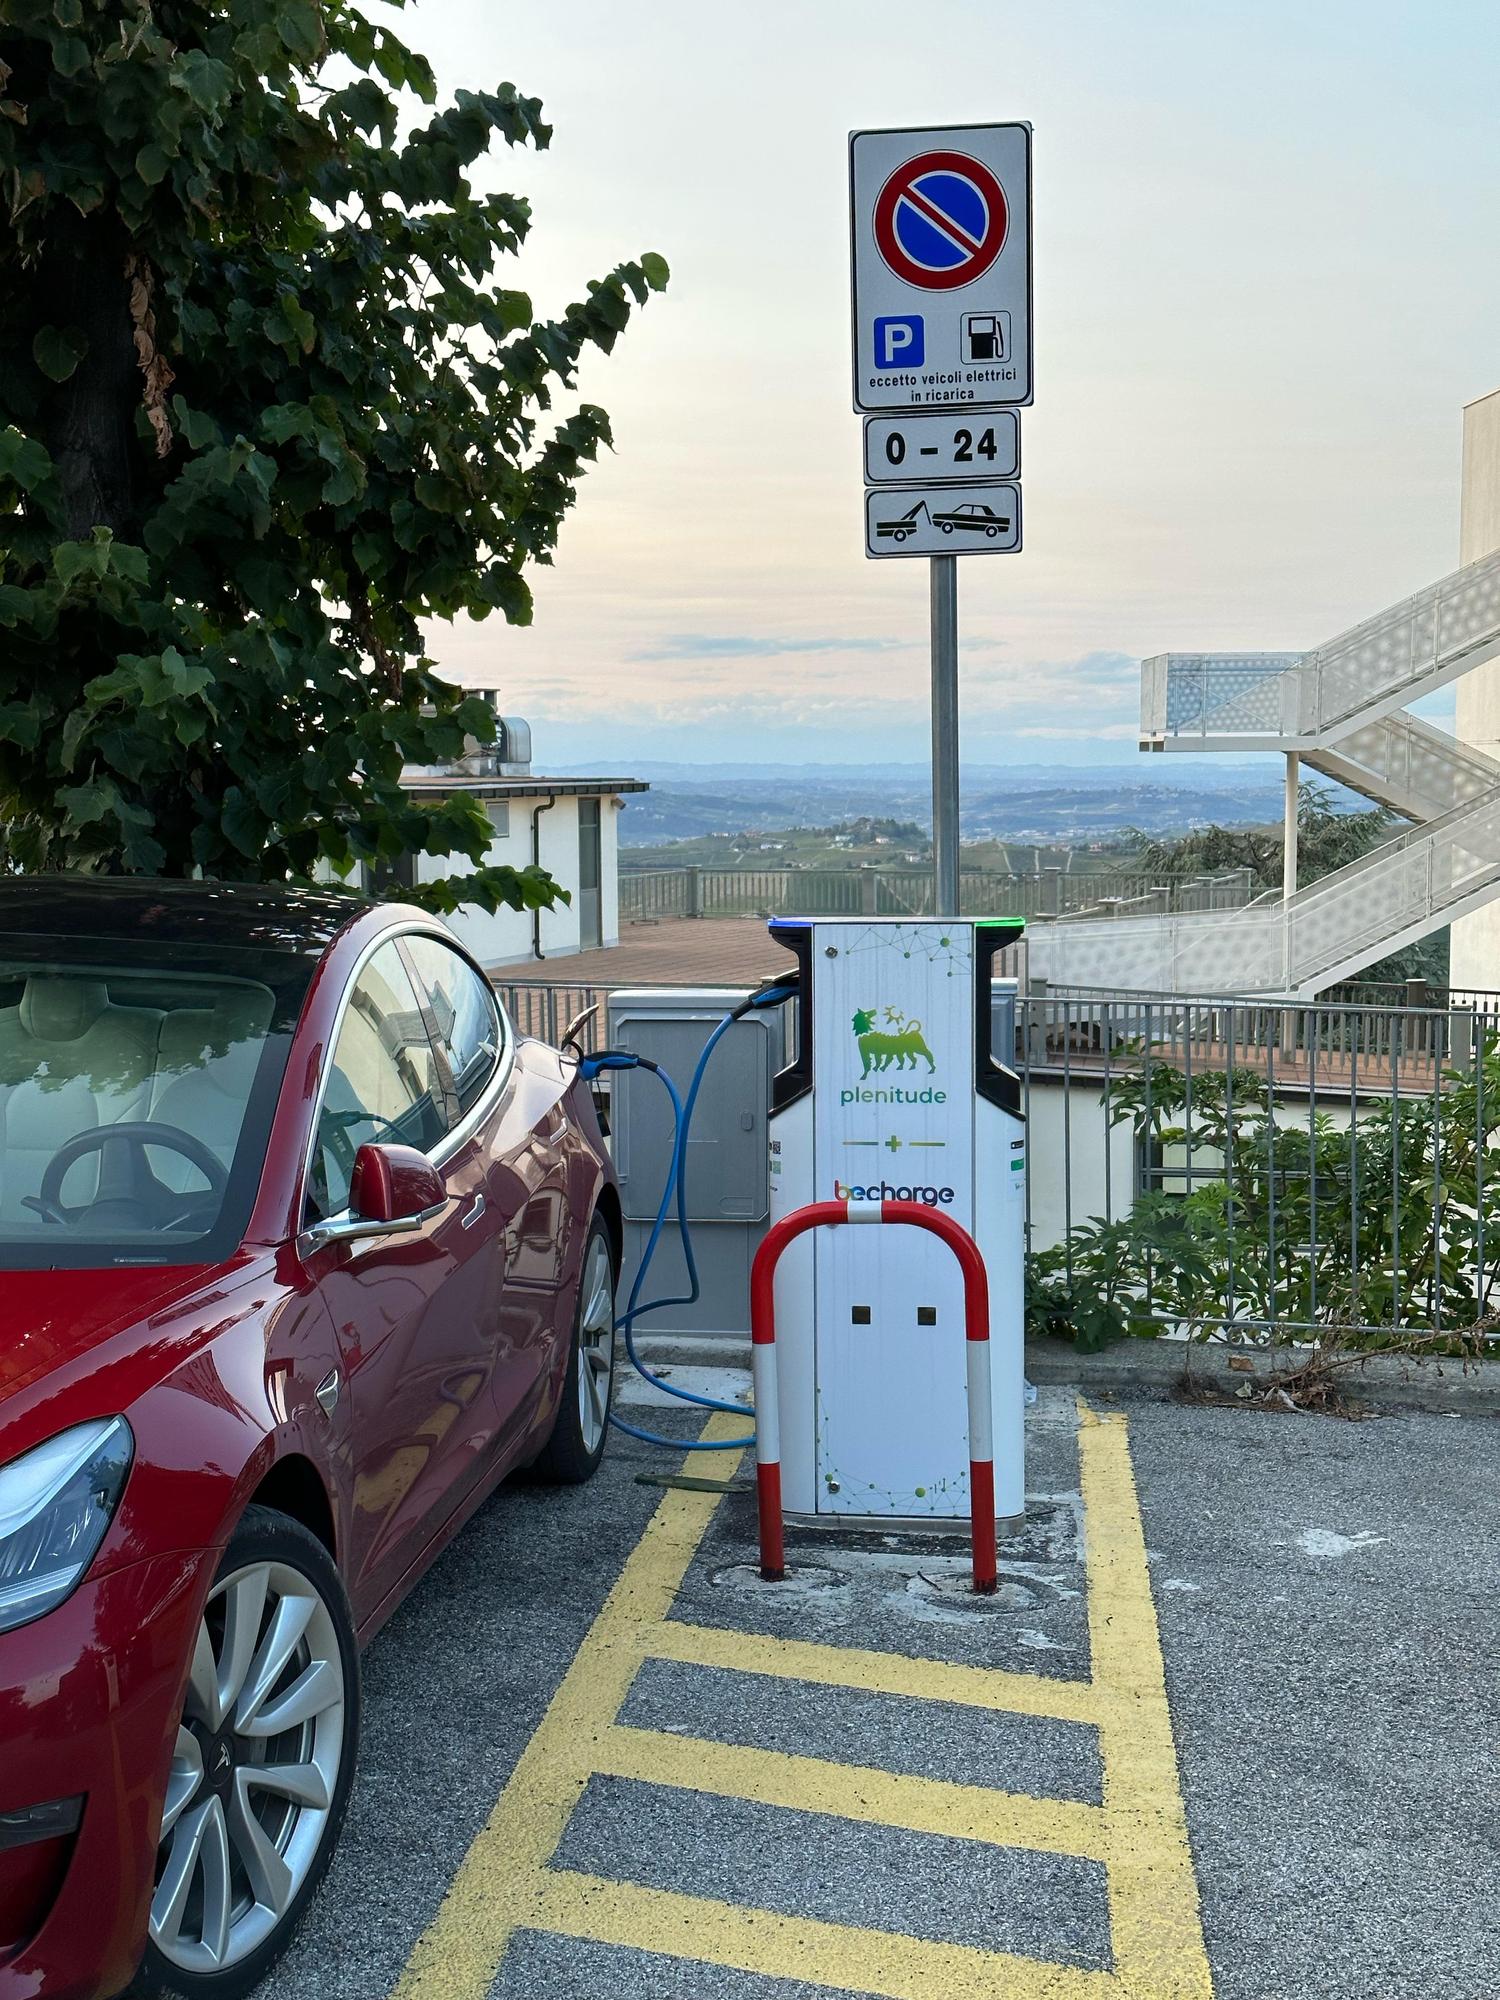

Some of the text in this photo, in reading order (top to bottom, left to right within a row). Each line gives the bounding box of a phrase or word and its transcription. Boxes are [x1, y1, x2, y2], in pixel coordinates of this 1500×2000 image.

[884, 323, 913, 362] P
[869, 368, 1017, 387] eccetto veicoli elettrici
[911, 388, 975, 402] in ricarica
[885, 432, 906, 465] 0
[953, 428, 998, 462] 24
[840, 1086, 947, 1107] plenitude
[834, 1180, 955, 1208] becharge
